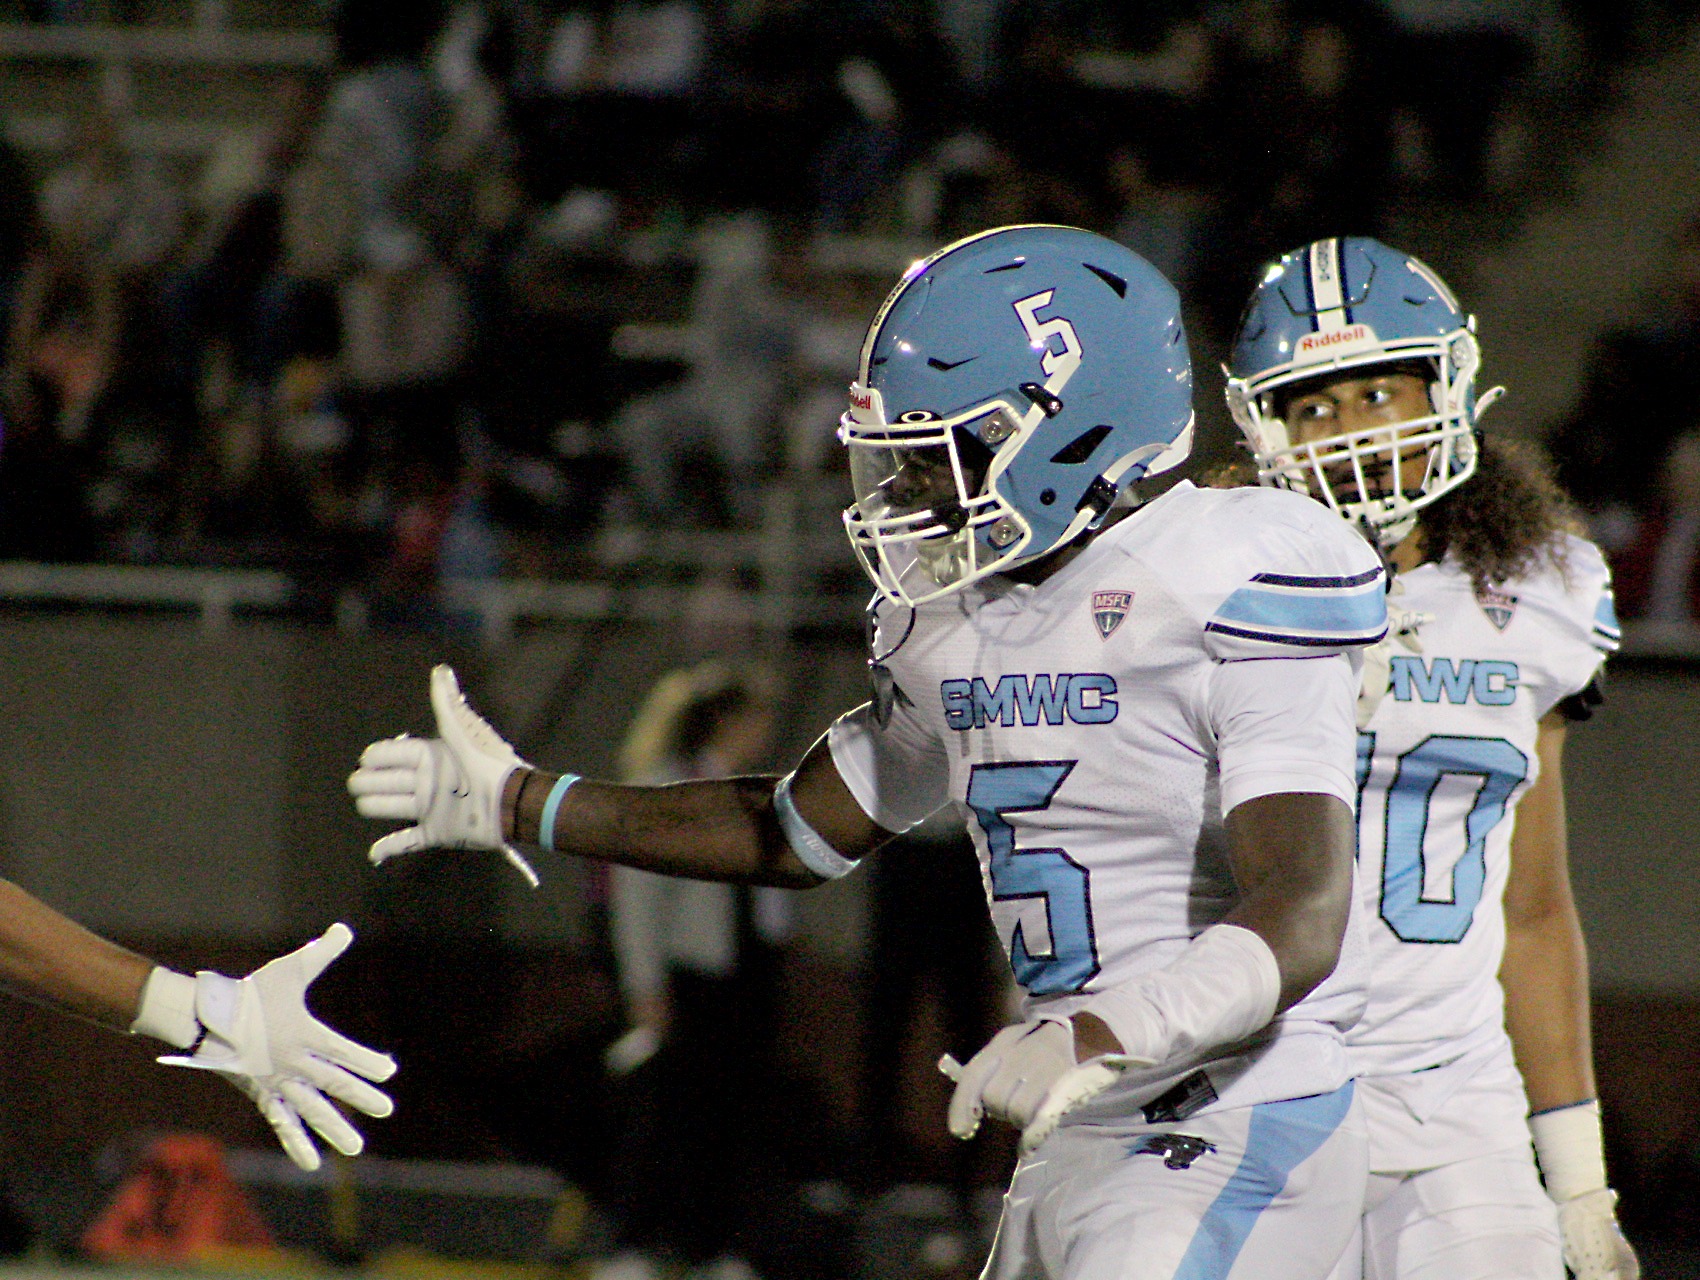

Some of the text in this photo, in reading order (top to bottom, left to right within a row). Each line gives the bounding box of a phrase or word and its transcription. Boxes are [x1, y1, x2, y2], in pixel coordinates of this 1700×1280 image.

[1011, 286, 1084, 377] 5
[1303, 327, 1364, 351] Riddell
[1094, 594, 1130, 608] MSFL
[940, 673, 1119, 730] SMWC
[1356, 727, 1527, 944] 0
[966, 759, 1101, 997] 5
